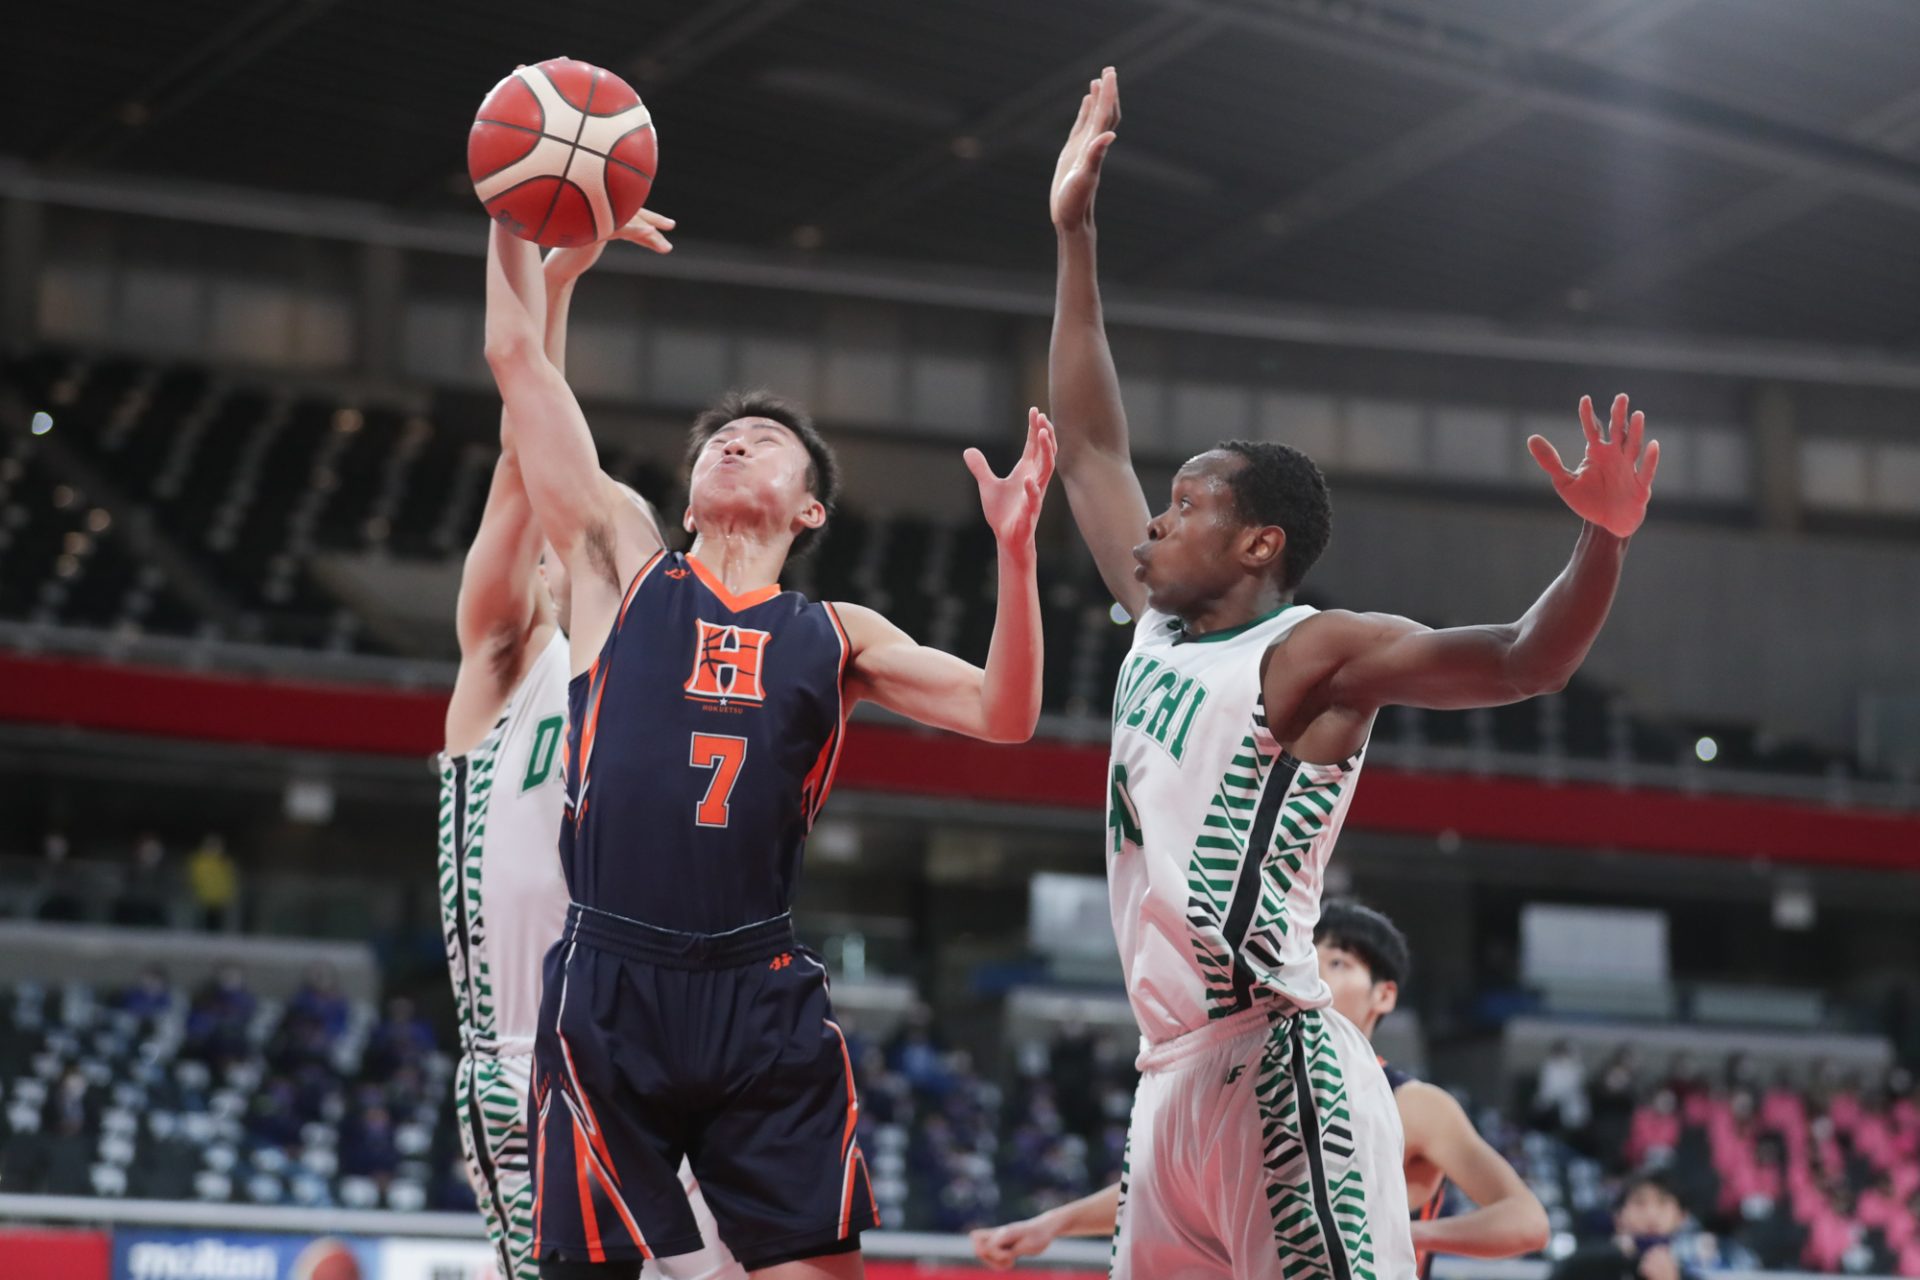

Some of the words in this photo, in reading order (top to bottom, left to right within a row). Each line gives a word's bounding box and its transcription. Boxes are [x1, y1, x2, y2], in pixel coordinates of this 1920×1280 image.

[684, 618, 771, 701] H
[521, 715, 565, 793] D
[689, 732, 748, 828] 7
